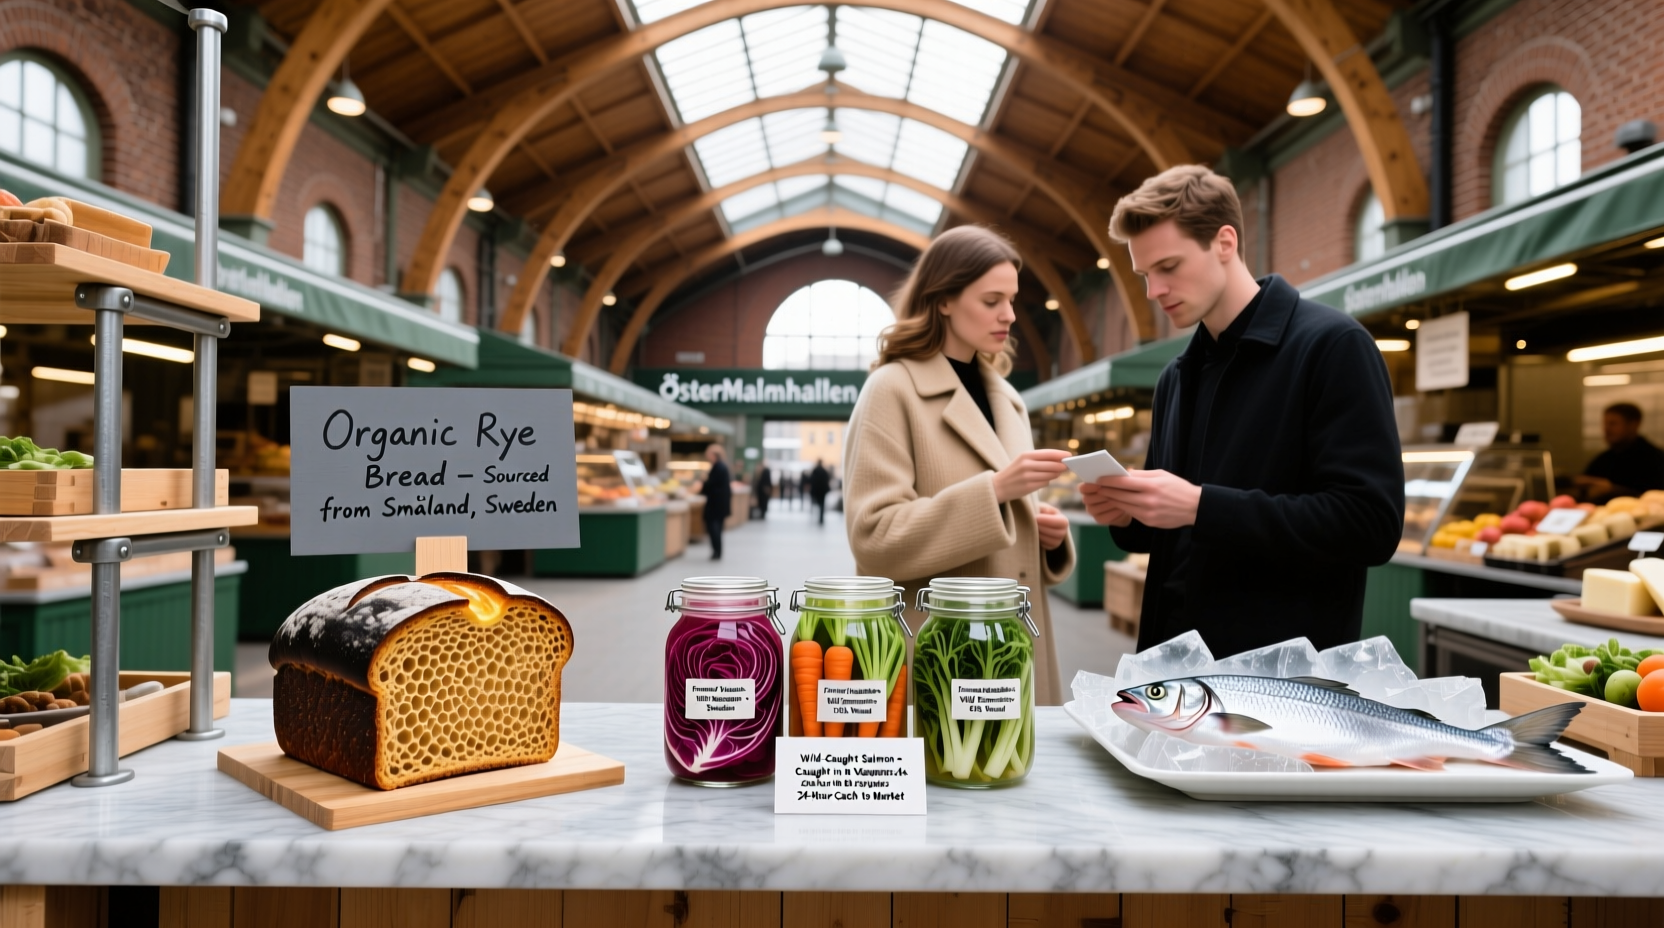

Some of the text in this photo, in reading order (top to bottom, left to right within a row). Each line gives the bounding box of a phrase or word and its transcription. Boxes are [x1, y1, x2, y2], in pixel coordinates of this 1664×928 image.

[323, 409, 536, 461] Organic Rye
[365, 460, 447, 489] Bread
[483, 464, 550, 484] Sourced
[320, 496, 371, 522] from
[485, 491, 557, 514] Sweden
